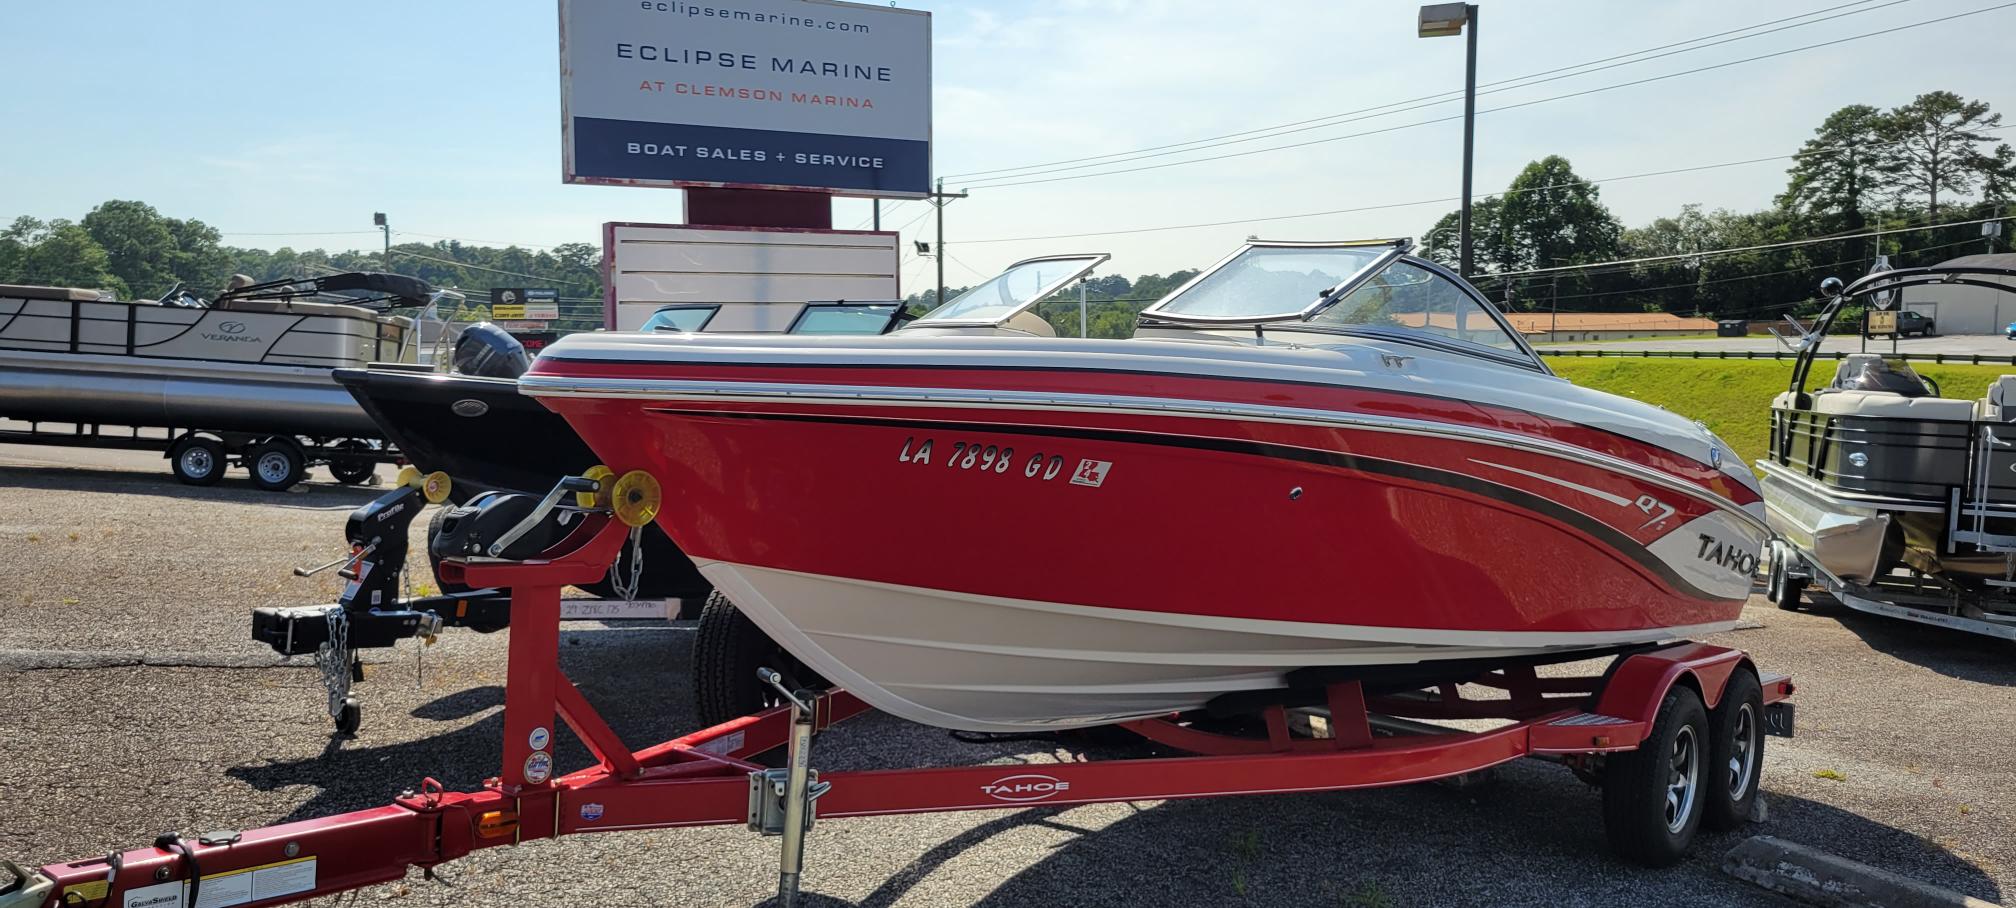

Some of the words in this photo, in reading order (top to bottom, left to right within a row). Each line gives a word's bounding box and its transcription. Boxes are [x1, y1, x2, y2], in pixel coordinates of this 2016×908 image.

[641, 1, 869, 33] eclipsemarine.com
[617, 43, 757, 70] ECLIPSE
[772, 57, 891, 82] MARINE
[639, 80, 665, 92] AT
[675, 83, 782, 101] CLEMSON
[791, 92, 873, 109] MARINA
[627, 143, 687, 157] BOAT
[696, 147, 766, 161] SALES
[795, 153, 884, 168] SERVICE
[201, 332, 261, 342] VERANDA
[899, 436, 933, 465] LA
[947, 441, 1014, 474] 7898
[1024, 453, 1064, 481] GD
[980, 782, 1070, 794] TAHOE
